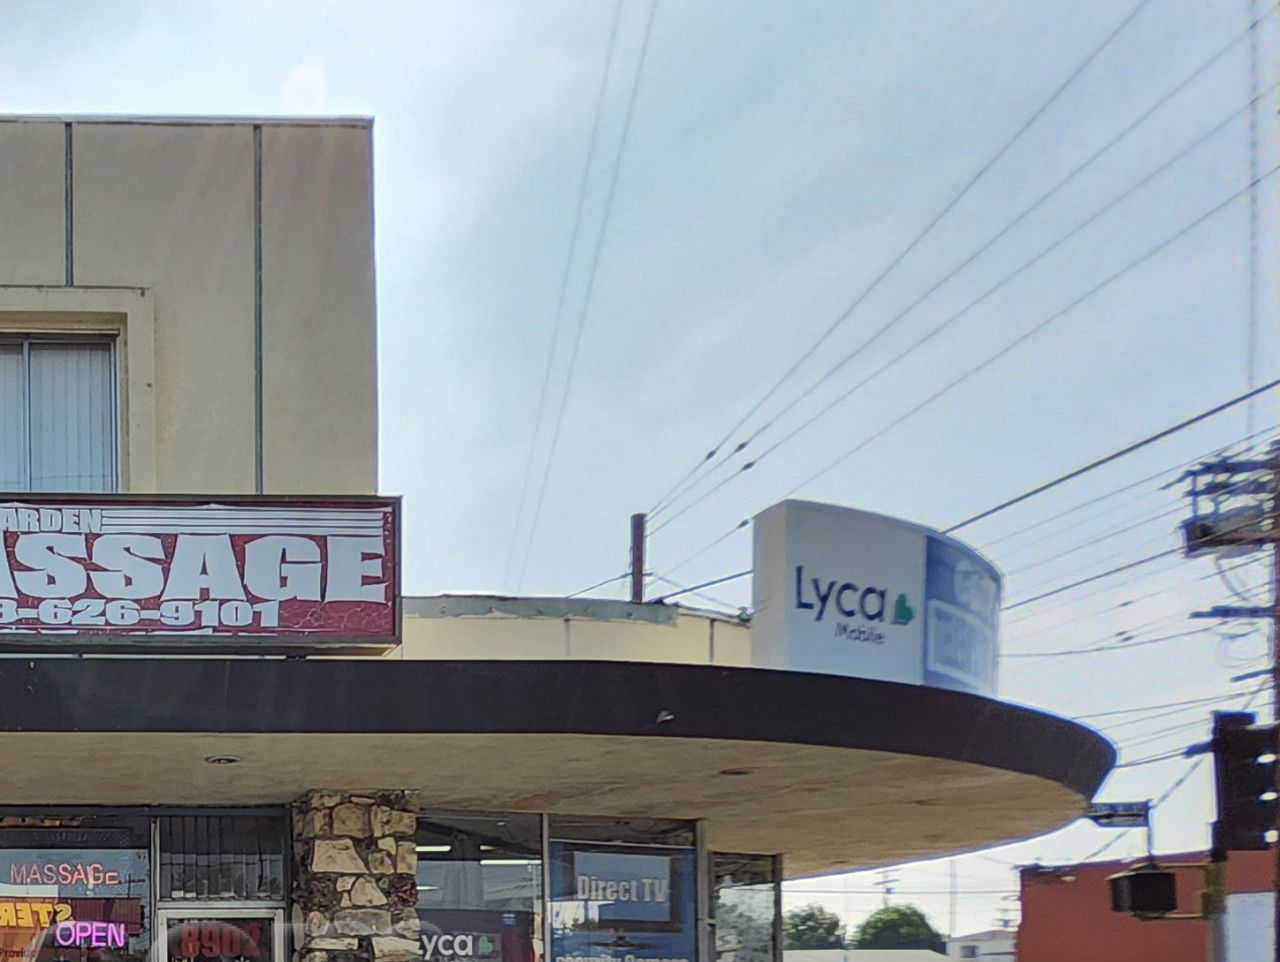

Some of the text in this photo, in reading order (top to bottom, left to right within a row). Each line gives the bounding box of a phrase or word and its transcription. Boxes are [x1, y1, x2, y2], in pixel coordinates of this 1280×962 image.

[795, 565, 888, 622] Lyca
[577, 874, 667, 902] Direct TV
[55, 922, 125, 947] OPEN
[419, 934, 473, 960] yca
